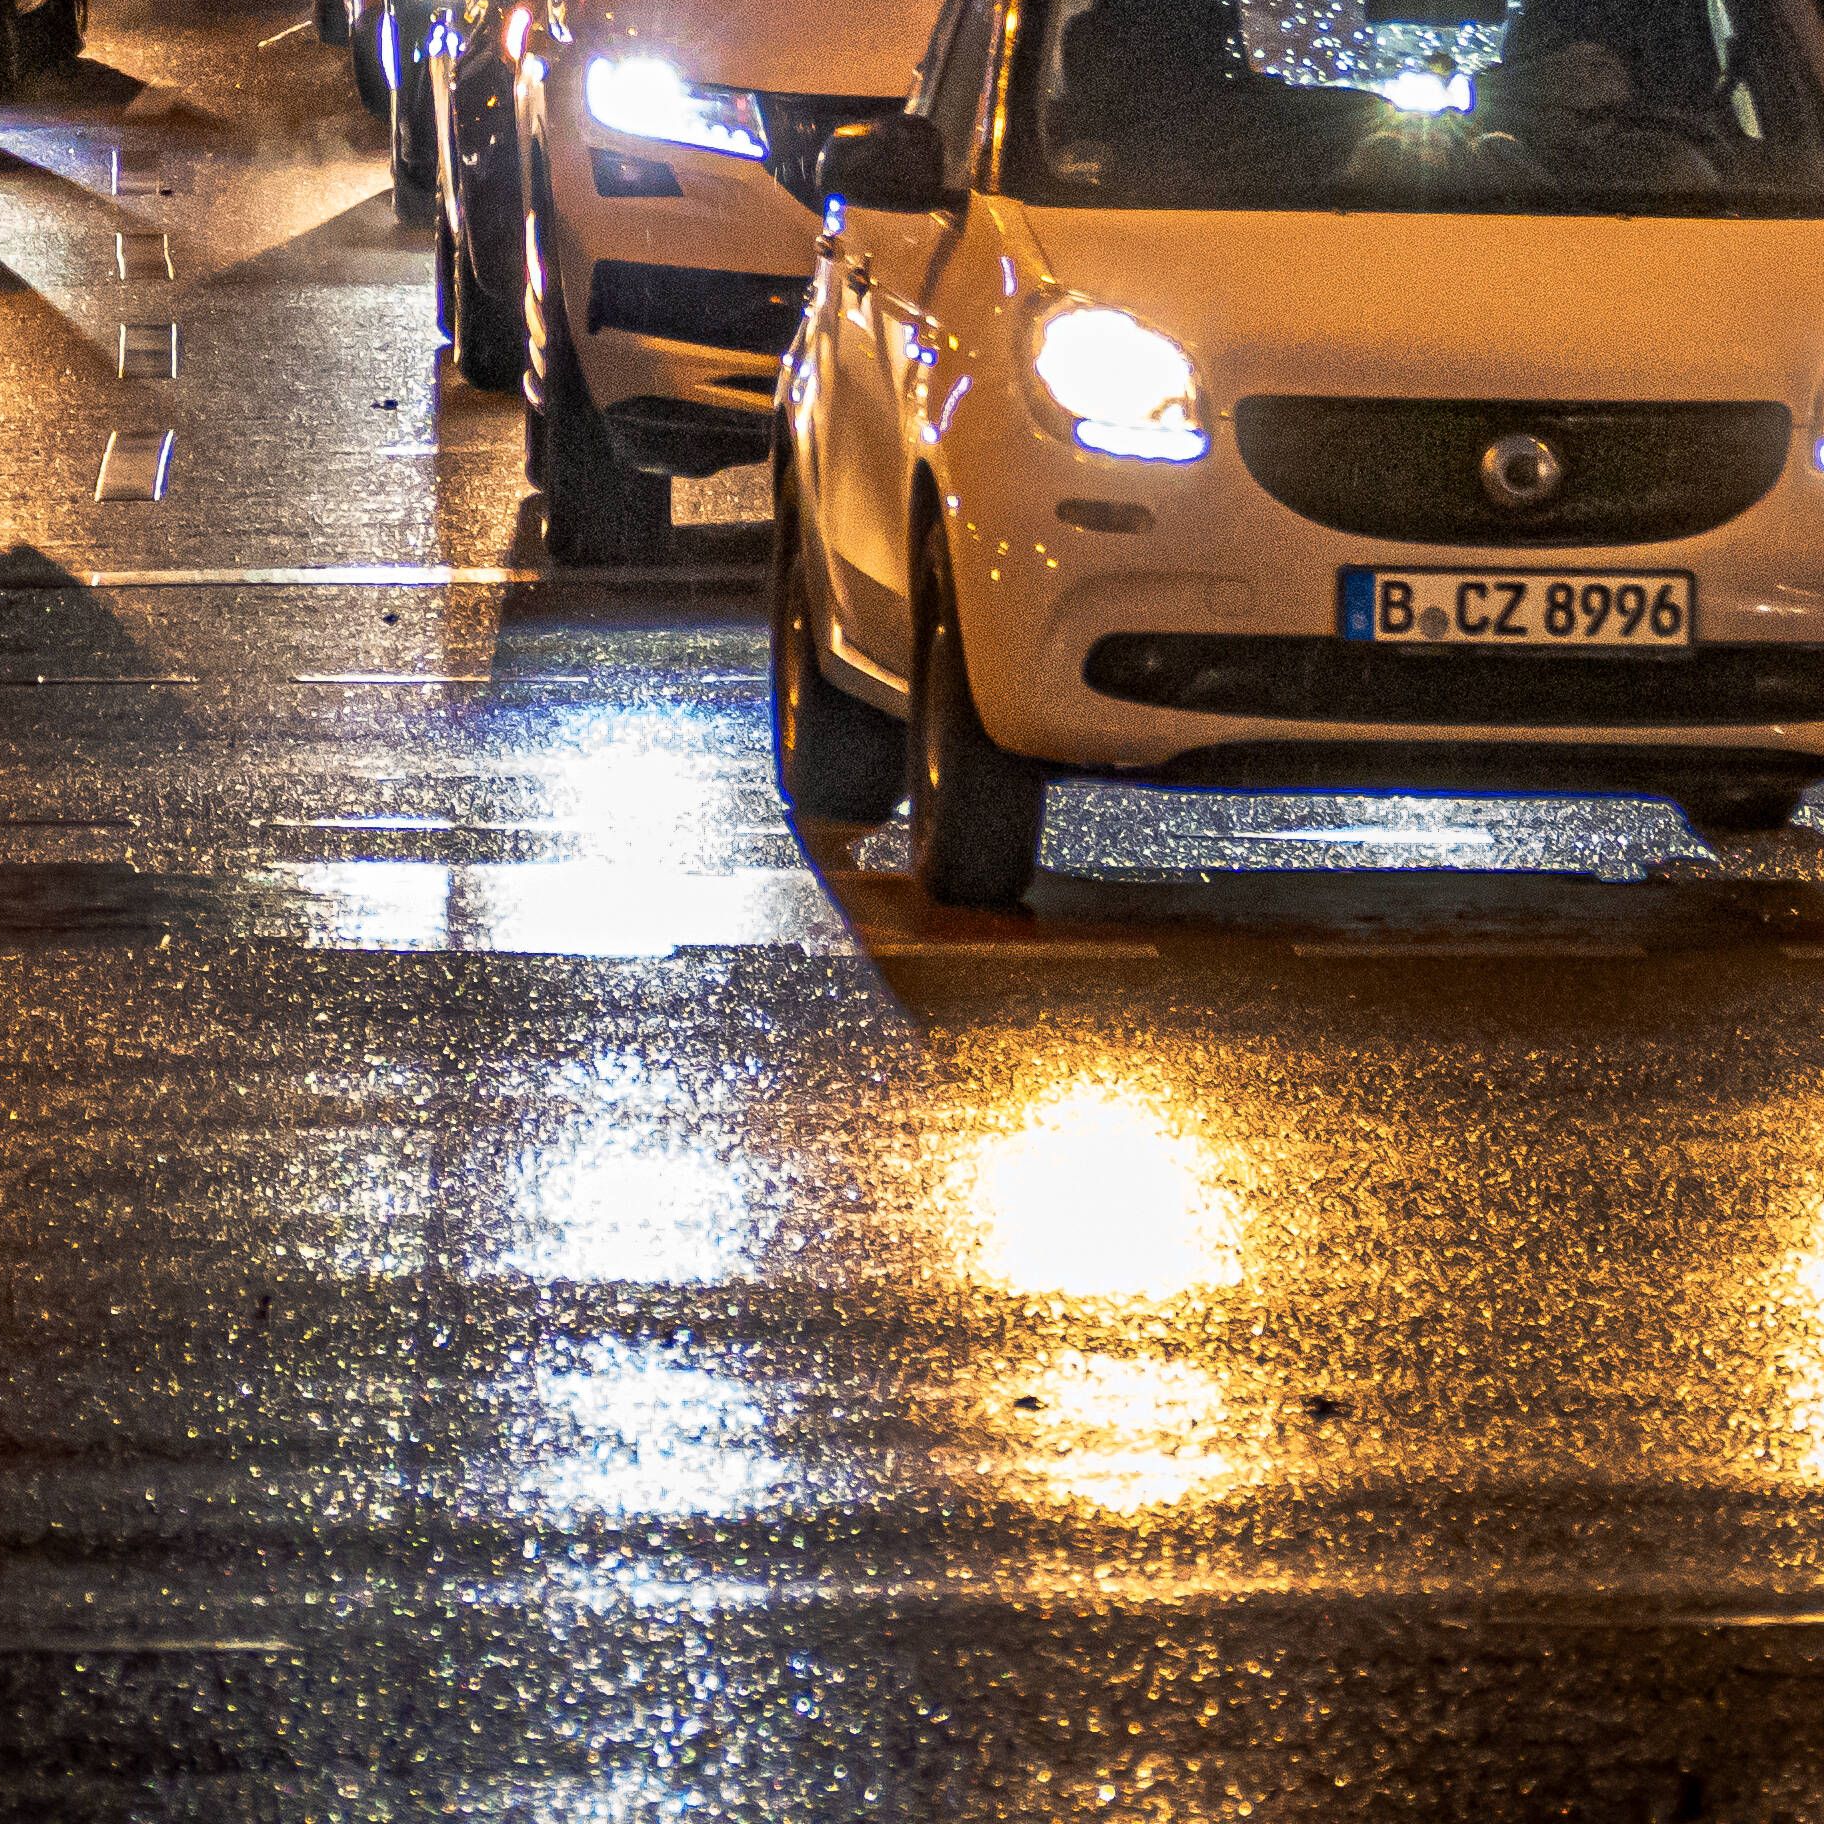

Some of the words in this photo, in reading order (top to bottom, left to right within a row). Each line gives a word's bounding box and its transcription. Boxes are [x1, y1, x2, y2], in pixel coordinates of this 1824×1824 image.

[1379, 580, 1415, 634] B
[1455, 581, 1528, 637] CZ
[1543, 582, 1682, 638] 8996
